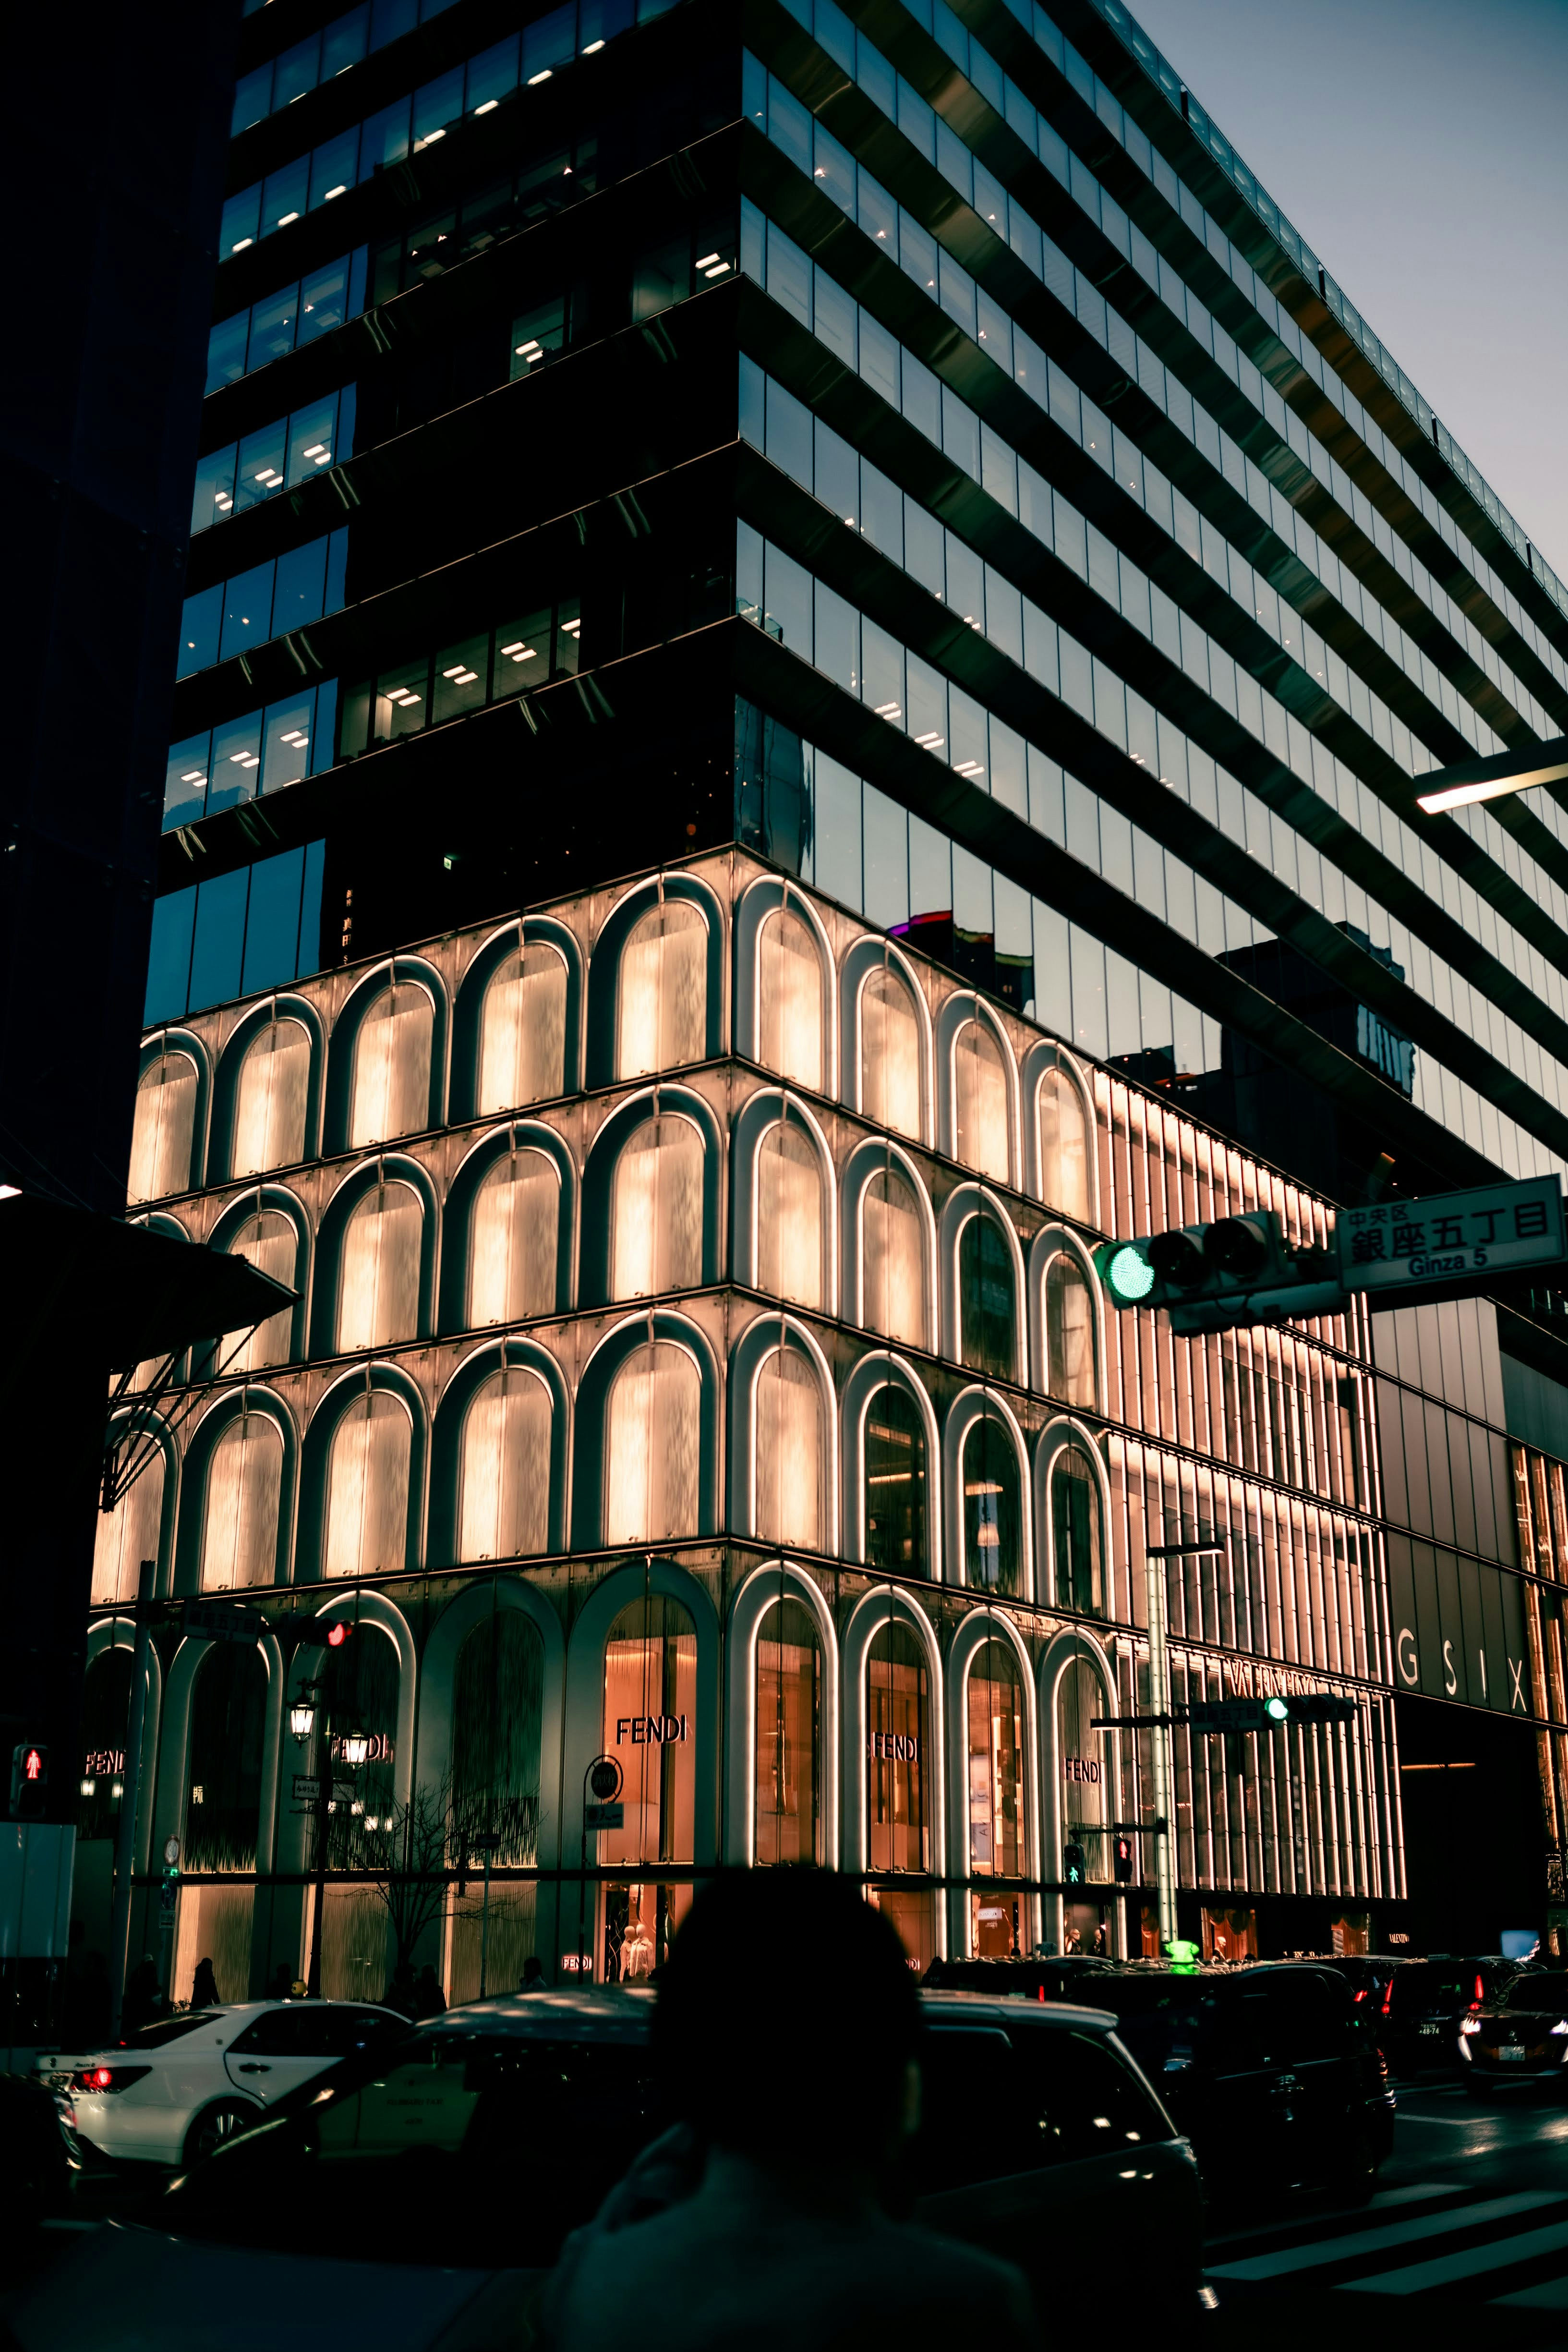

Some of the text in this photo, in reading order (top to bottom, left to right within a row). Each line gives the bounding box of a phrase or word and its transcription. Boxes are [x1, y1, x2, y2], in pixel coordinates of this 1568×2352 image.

[1349, 1203, 1408, 1227] 中央区
[1351, 1202, 1546, 1263] 銀座五丁目
[1409, 1248, 1487, 1276] Ginza 5
[617, 1714, 687, 1744] FENDI
[329, 1733, 386, 1762] FEDI
[874, 1732, 919, 1761] FENDI
[85, 1750, 126, 1774] FEND
[1065, 1758, 1101, 1783] FENDI
[1389, 1933, 1410, 1943] VALENTINO
[562, 1957, 590, 1968] FENDI
